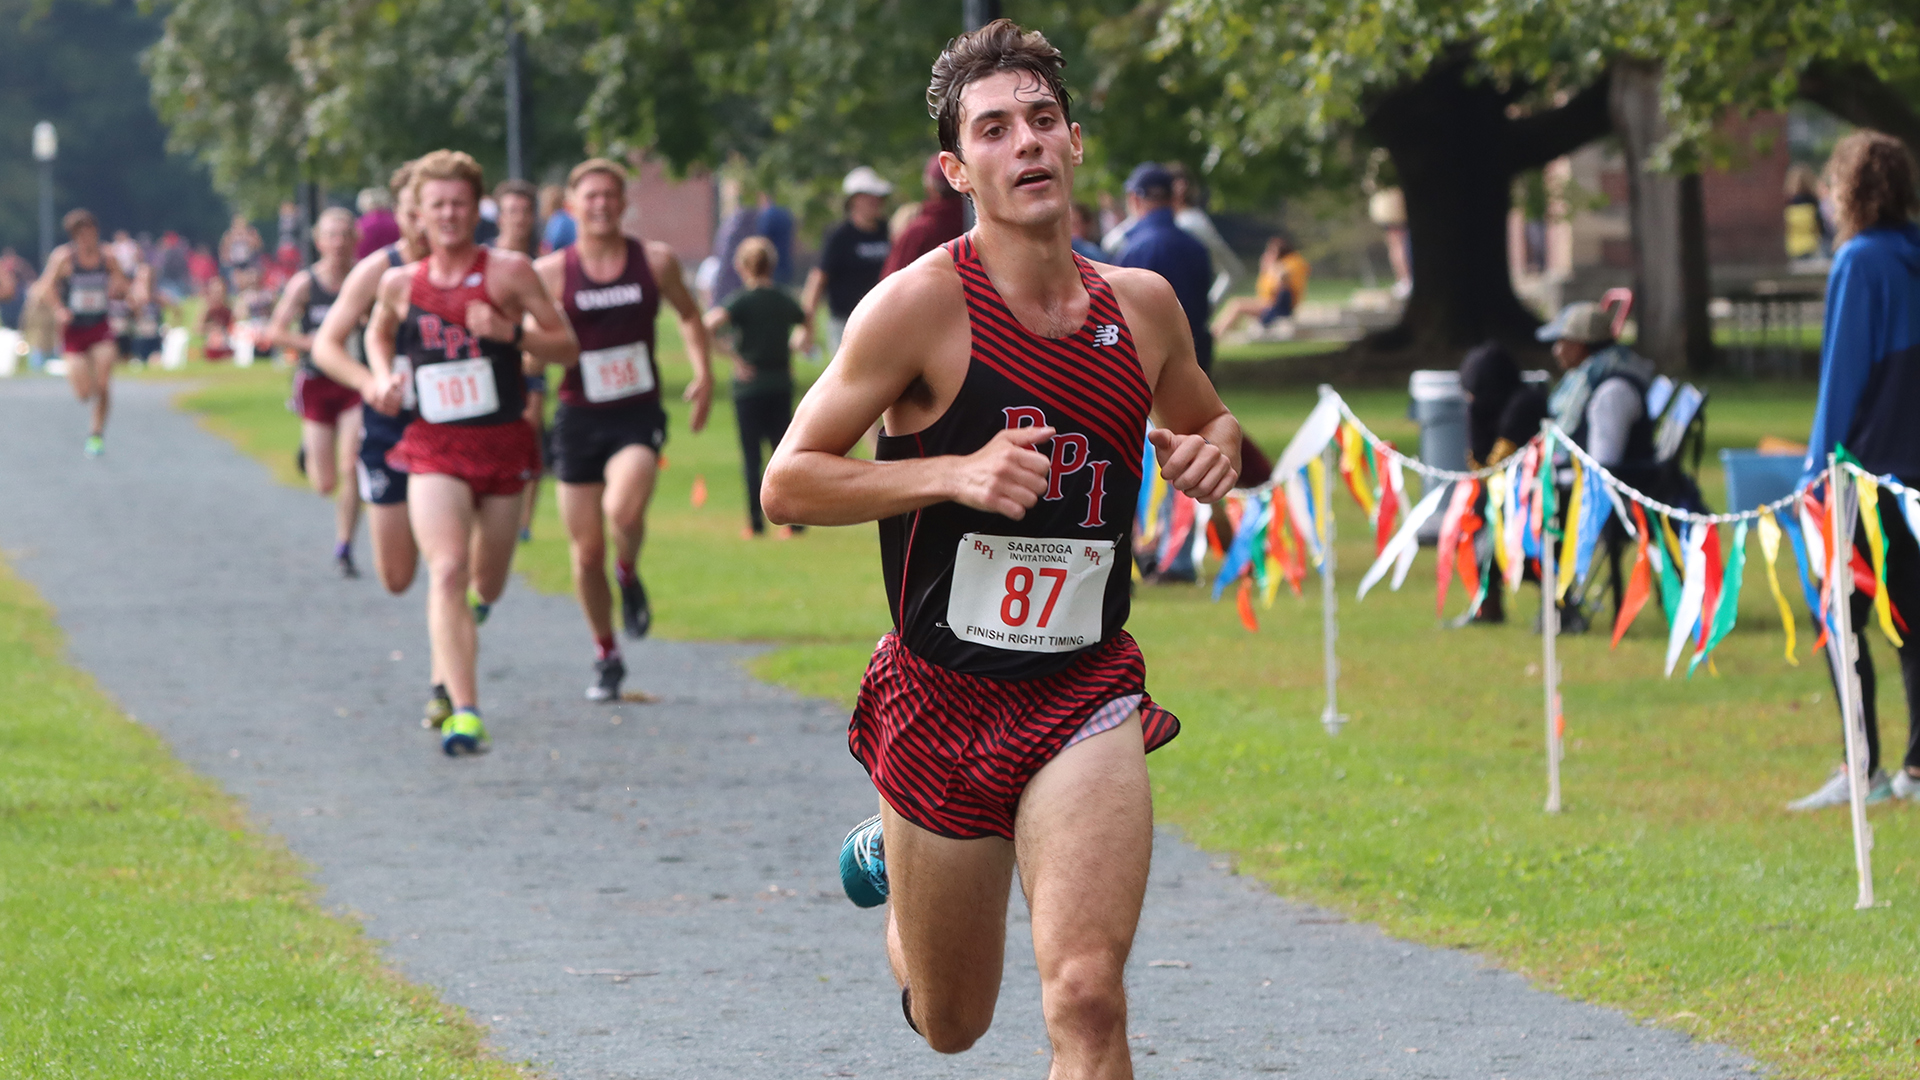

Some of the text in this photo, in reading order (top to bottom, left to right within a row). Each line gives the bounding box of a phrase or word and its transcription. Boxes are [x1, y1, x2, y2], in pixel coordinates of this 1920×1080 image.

[574, 283, 643, 311] UNION
[437, 376, 479, 408] 101
[974, 540, 994, 560] RPI
[1007, 541, 1073, 555] SARATOGA
[1009, 552, 1068, 564] INVITATIONAL
[1084, 546, 1101, 566] RPI
[1000, 566, 1068, 629] 87
[966, 625, 1085, 646] FINISH RIGHT TIMING
